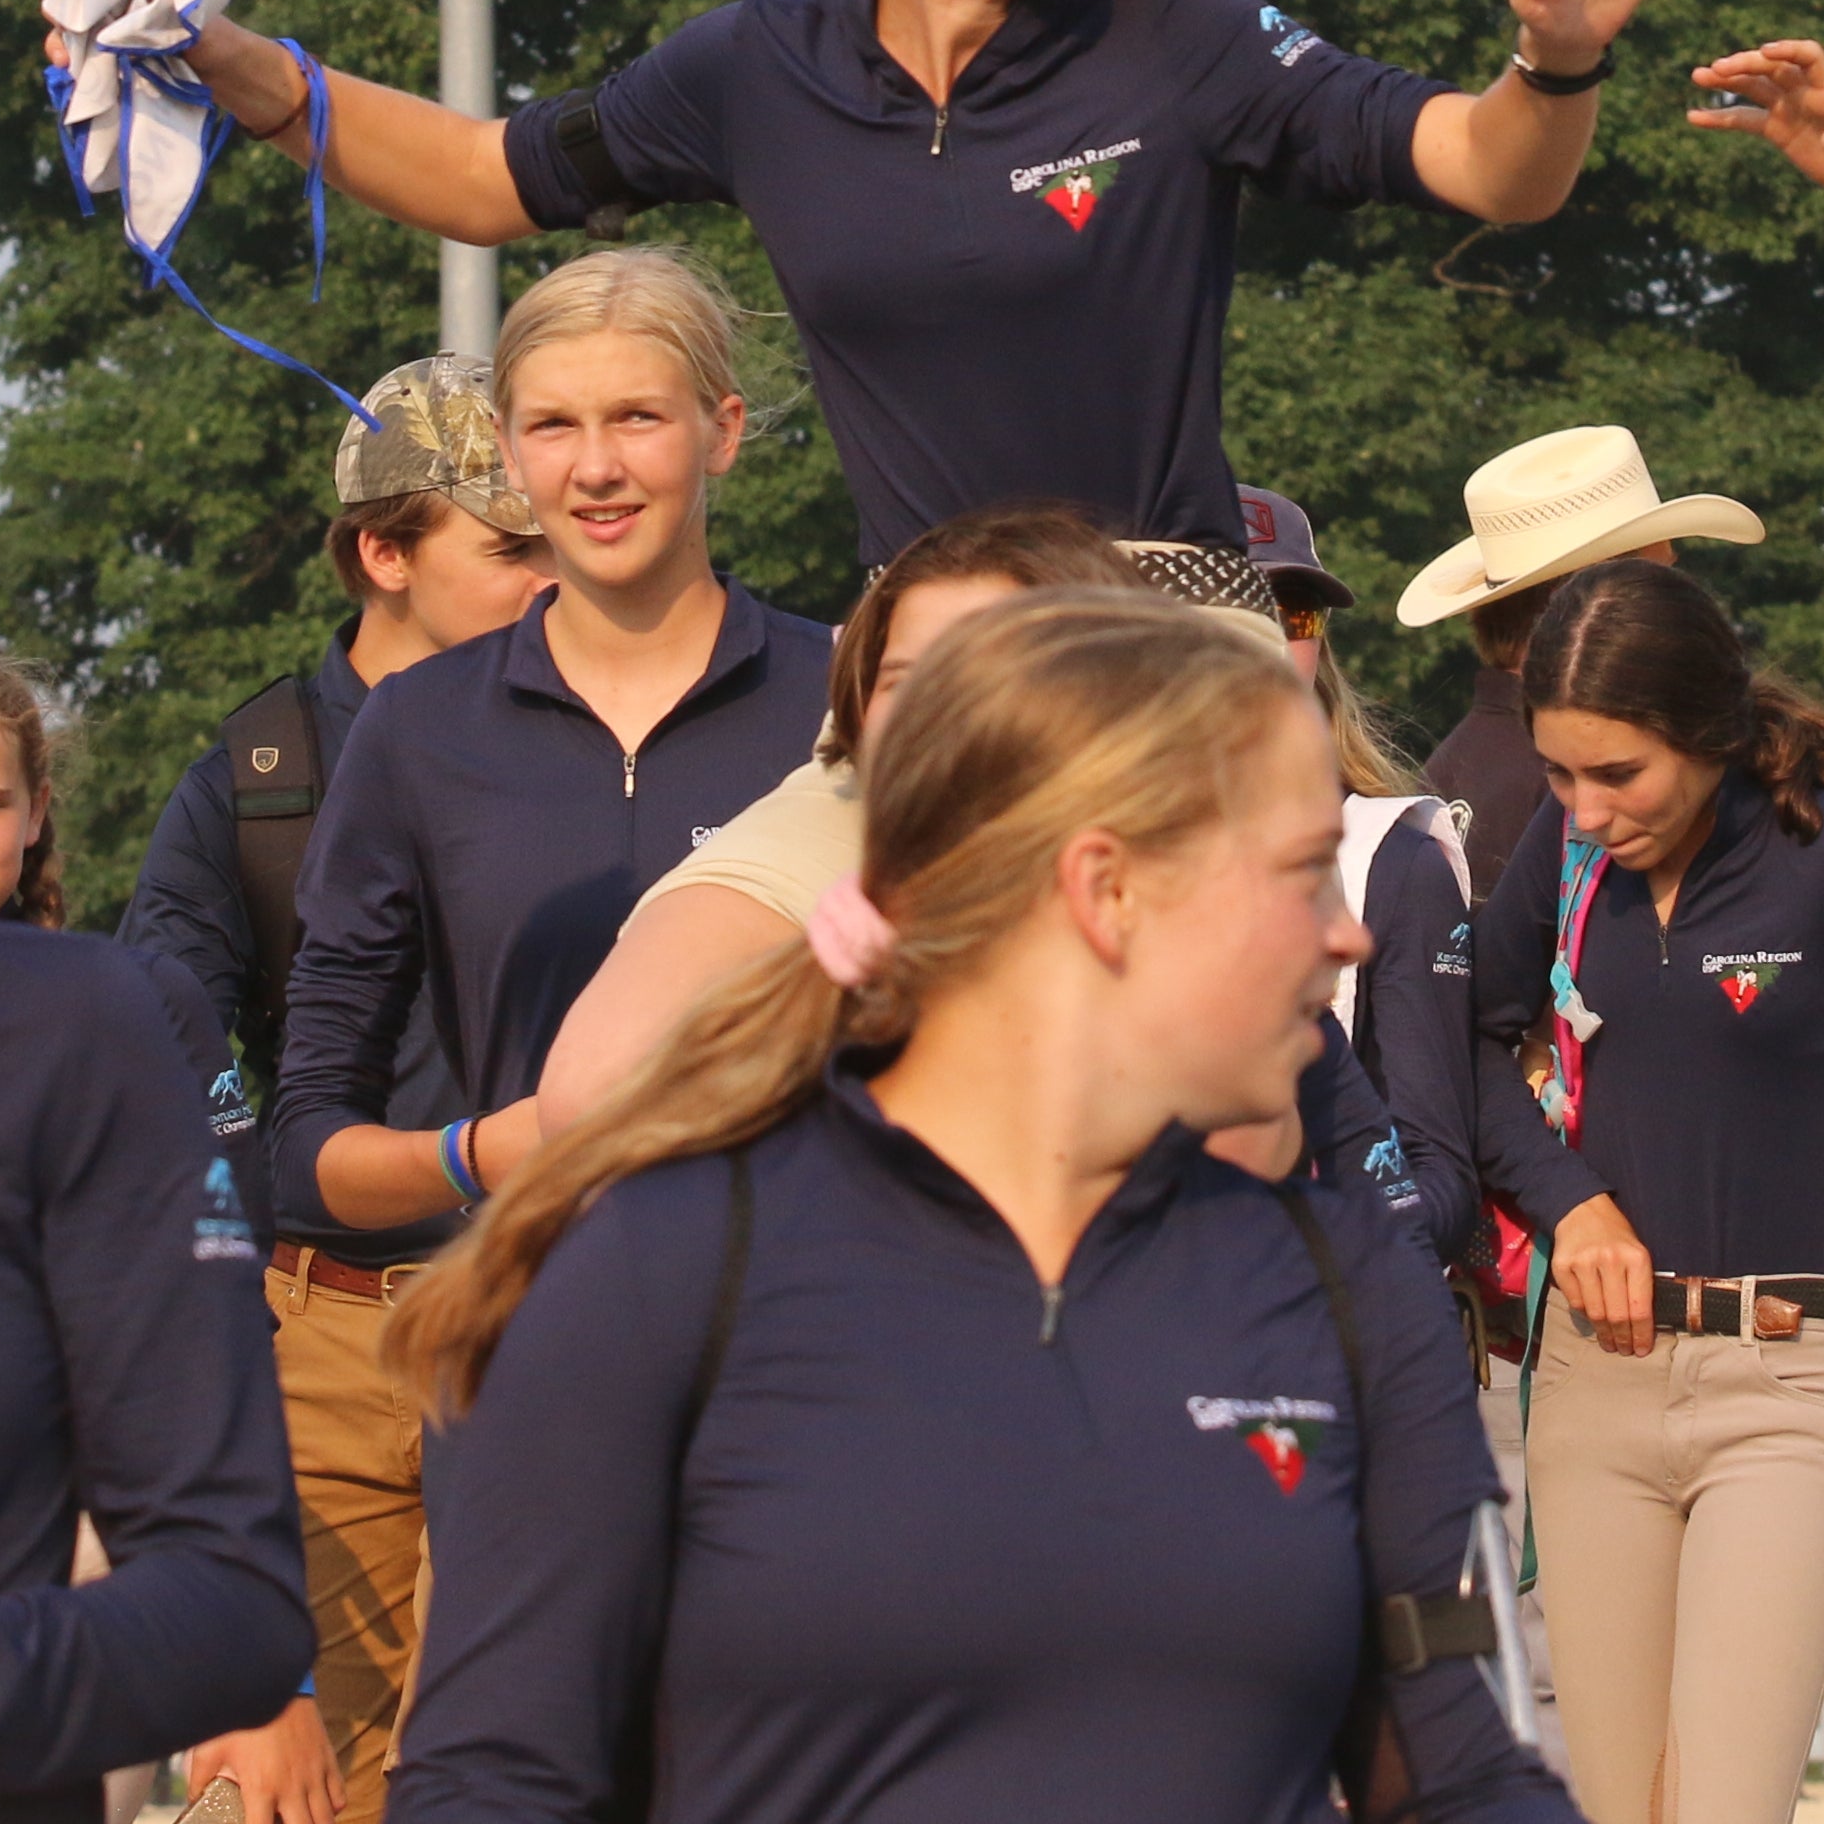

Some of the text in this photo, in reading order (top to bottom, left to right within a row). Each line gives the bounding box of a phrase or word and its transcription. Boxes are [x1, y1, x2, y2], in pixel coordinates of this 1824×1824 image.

[1010, 137, 1142, 182] CAROLINA REGION
[1702, 951, 1802, 965] CAROLINA REGION
[1432, 962, 1453, 974] USPC
[1702, 963, 1723, 974] USPC
